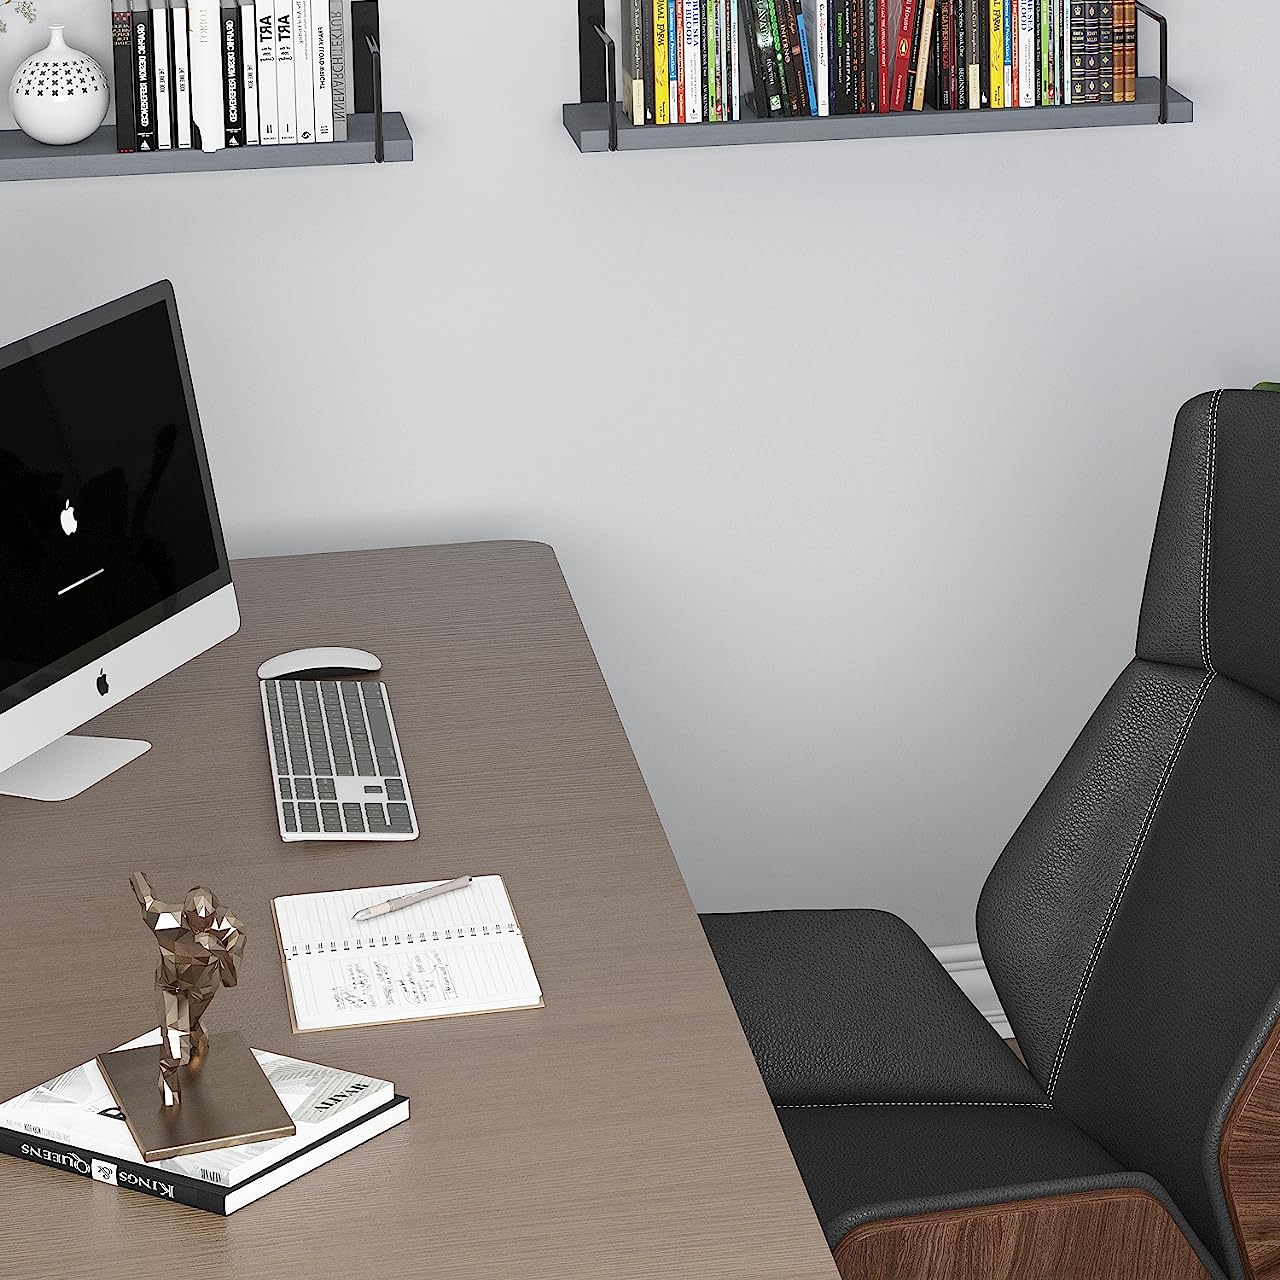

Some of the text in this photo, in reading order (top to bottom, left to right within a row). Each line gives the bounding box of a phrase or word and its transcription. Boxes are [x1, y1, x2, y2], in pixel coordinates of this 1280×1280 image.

[992, 9, 1001, 32] FARM
[656, 23, 665, 46] FARM
[20, 1143, 175, 1199] KINGS & QUEENS
